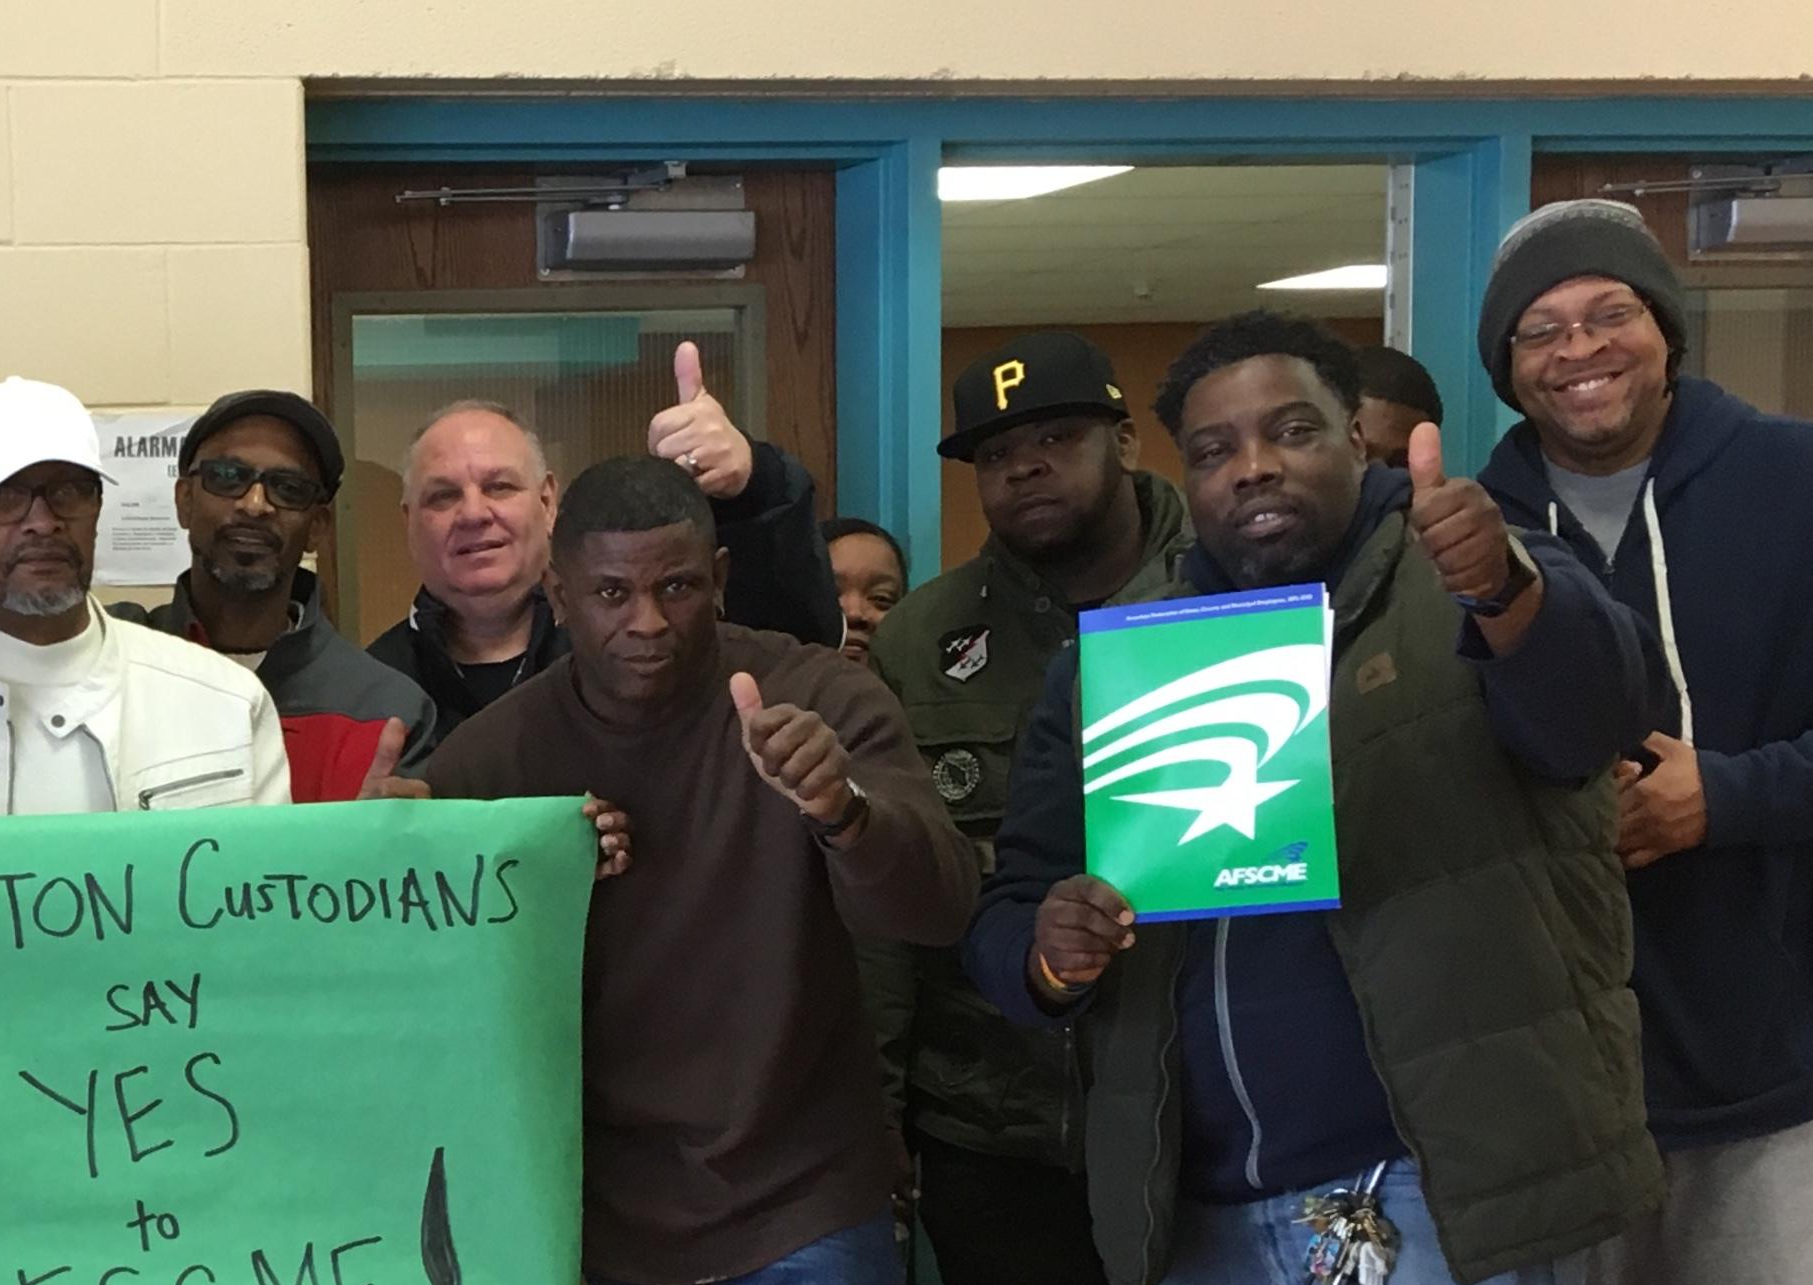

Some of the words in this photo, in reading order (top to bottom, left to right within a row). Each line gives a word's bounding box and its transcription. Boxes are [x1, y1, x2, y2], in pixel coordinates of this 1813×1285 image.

[993, 359, 1025, 411] P
[1214, 862, 1308, 888] AFSCME
[105, 973, 202, 1031] SAY
[19, 1052, 240, 1179] YES
[126, 1200, 180, 1251] to
